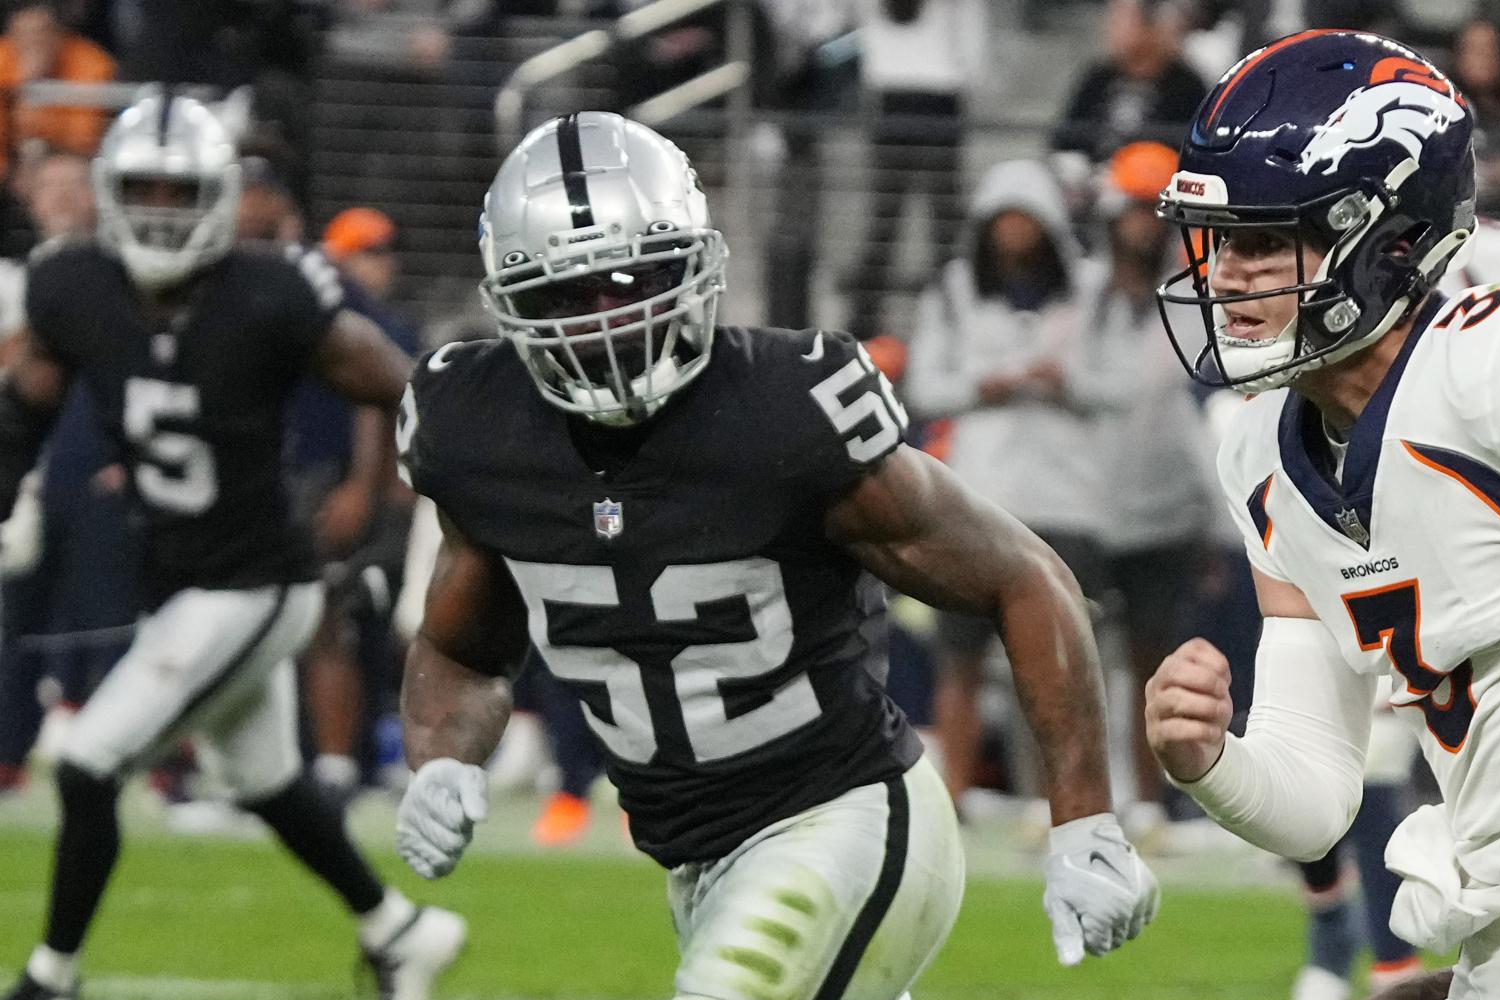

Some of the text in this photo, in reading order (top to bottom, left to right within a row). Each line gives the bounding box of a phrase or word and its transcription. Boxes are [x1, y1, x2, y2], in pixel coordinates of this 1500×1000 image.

[123, 376, 217, 513] 5
[809, 341, 909, 462] 5
[1340, 556, 1399, 579] BRONCOS
[502, 554, 822, 763] 52
